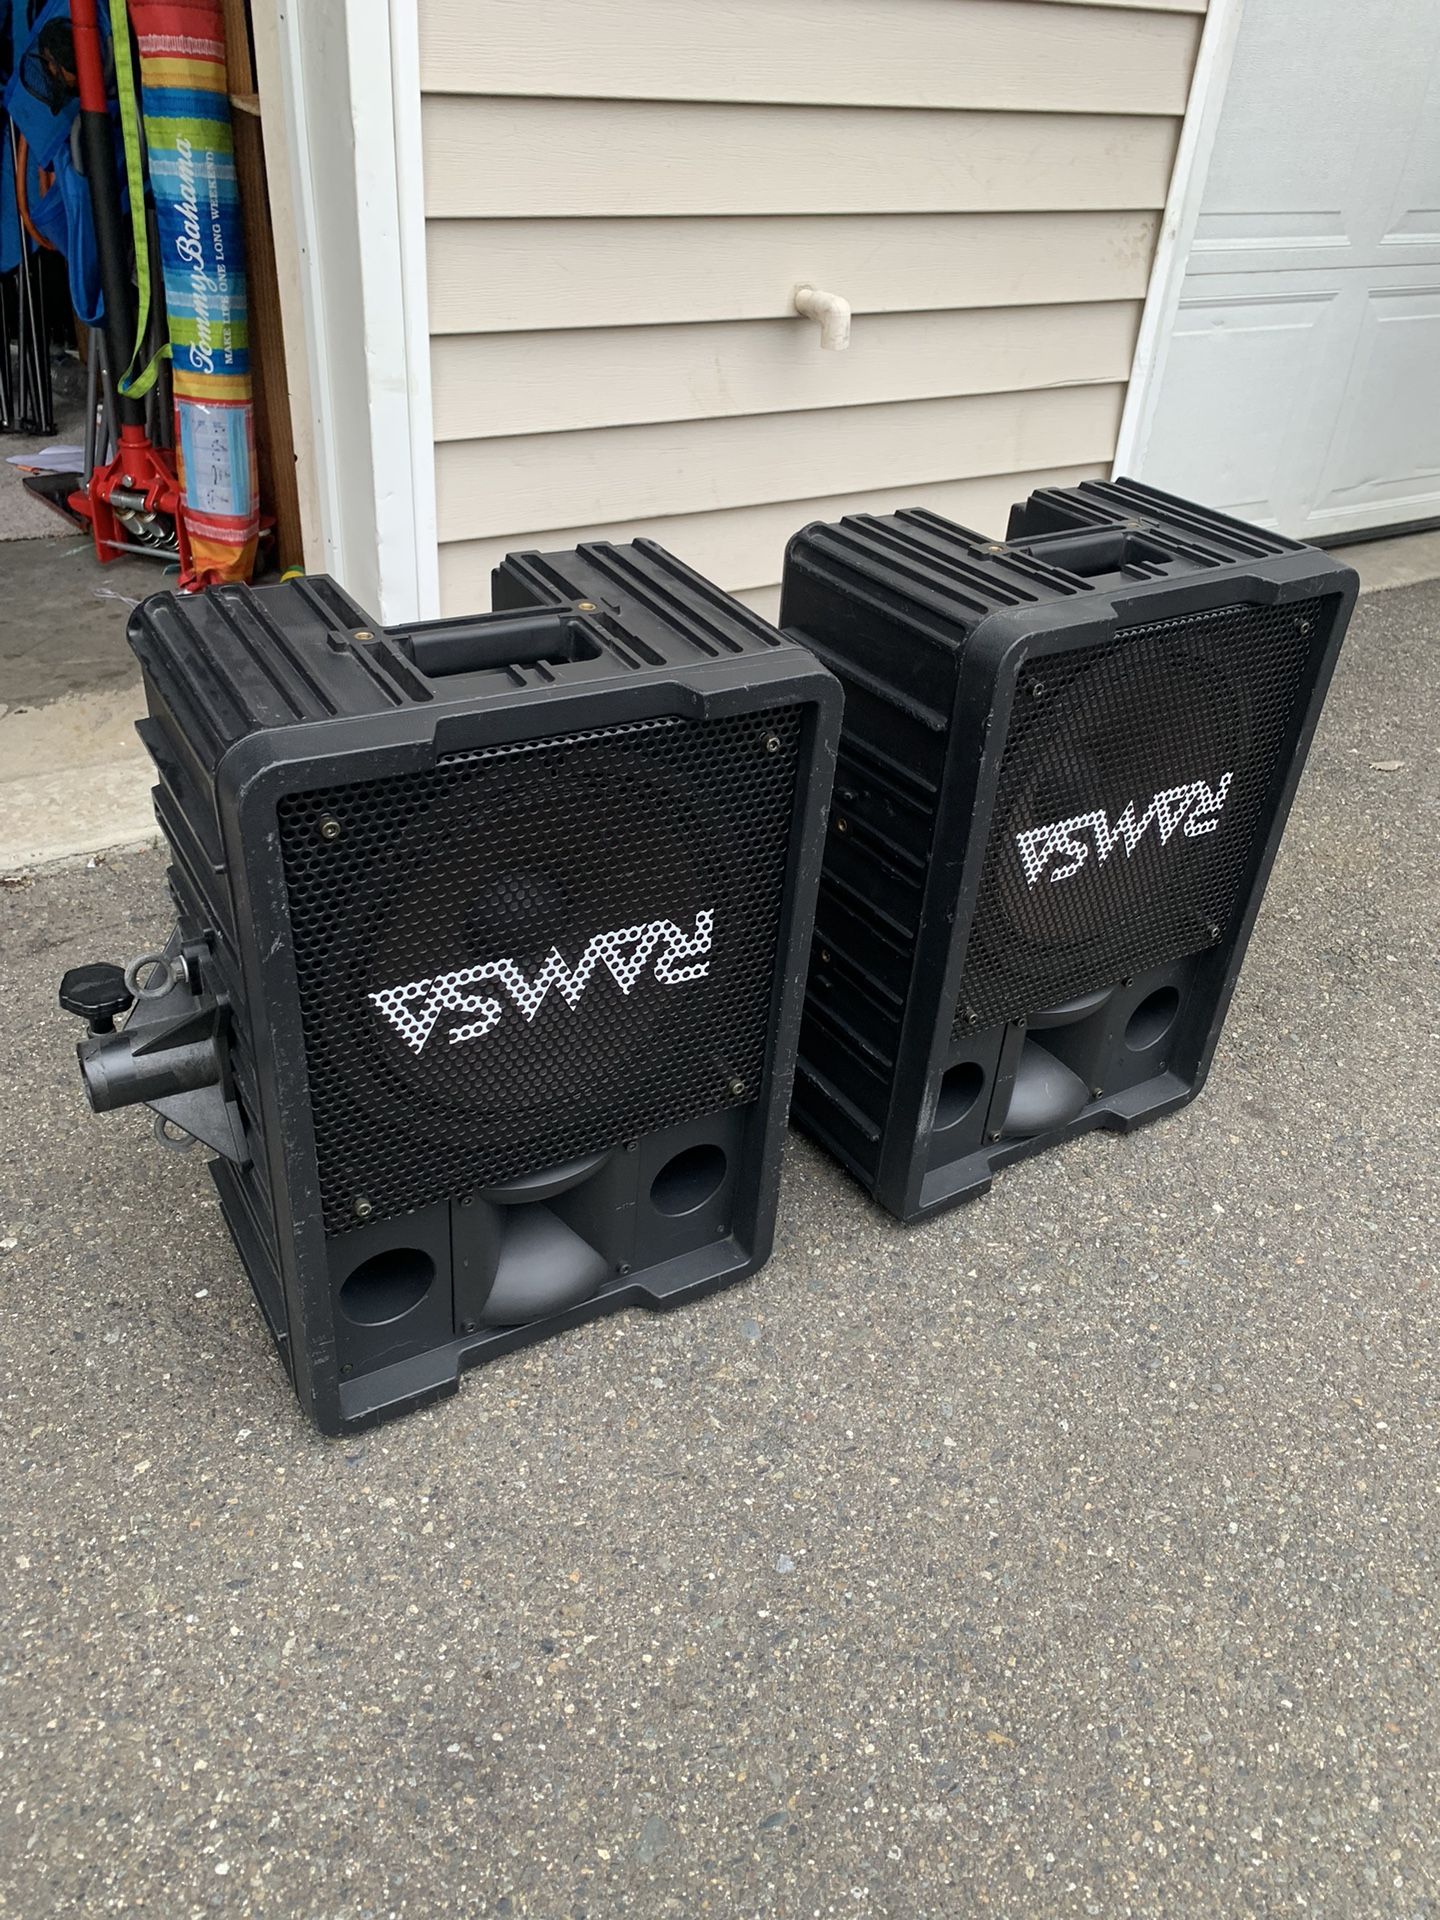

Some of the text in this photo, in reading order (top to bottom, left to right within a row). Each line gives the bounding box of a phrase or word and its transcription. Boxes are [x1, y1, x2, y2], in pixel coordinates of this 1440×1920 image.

[174, 138, 217, 374] Tommy Bahama
[213, 224, 225, 261] LONG
[217, 264, 228, 292] ONE
[221, 296, 231, 324] LIFE
[223, 328, 234, 365] MAKE
[1016, 771, 1234, 890] RAMSA
[368, 908, 715, 1055] RAMSA
